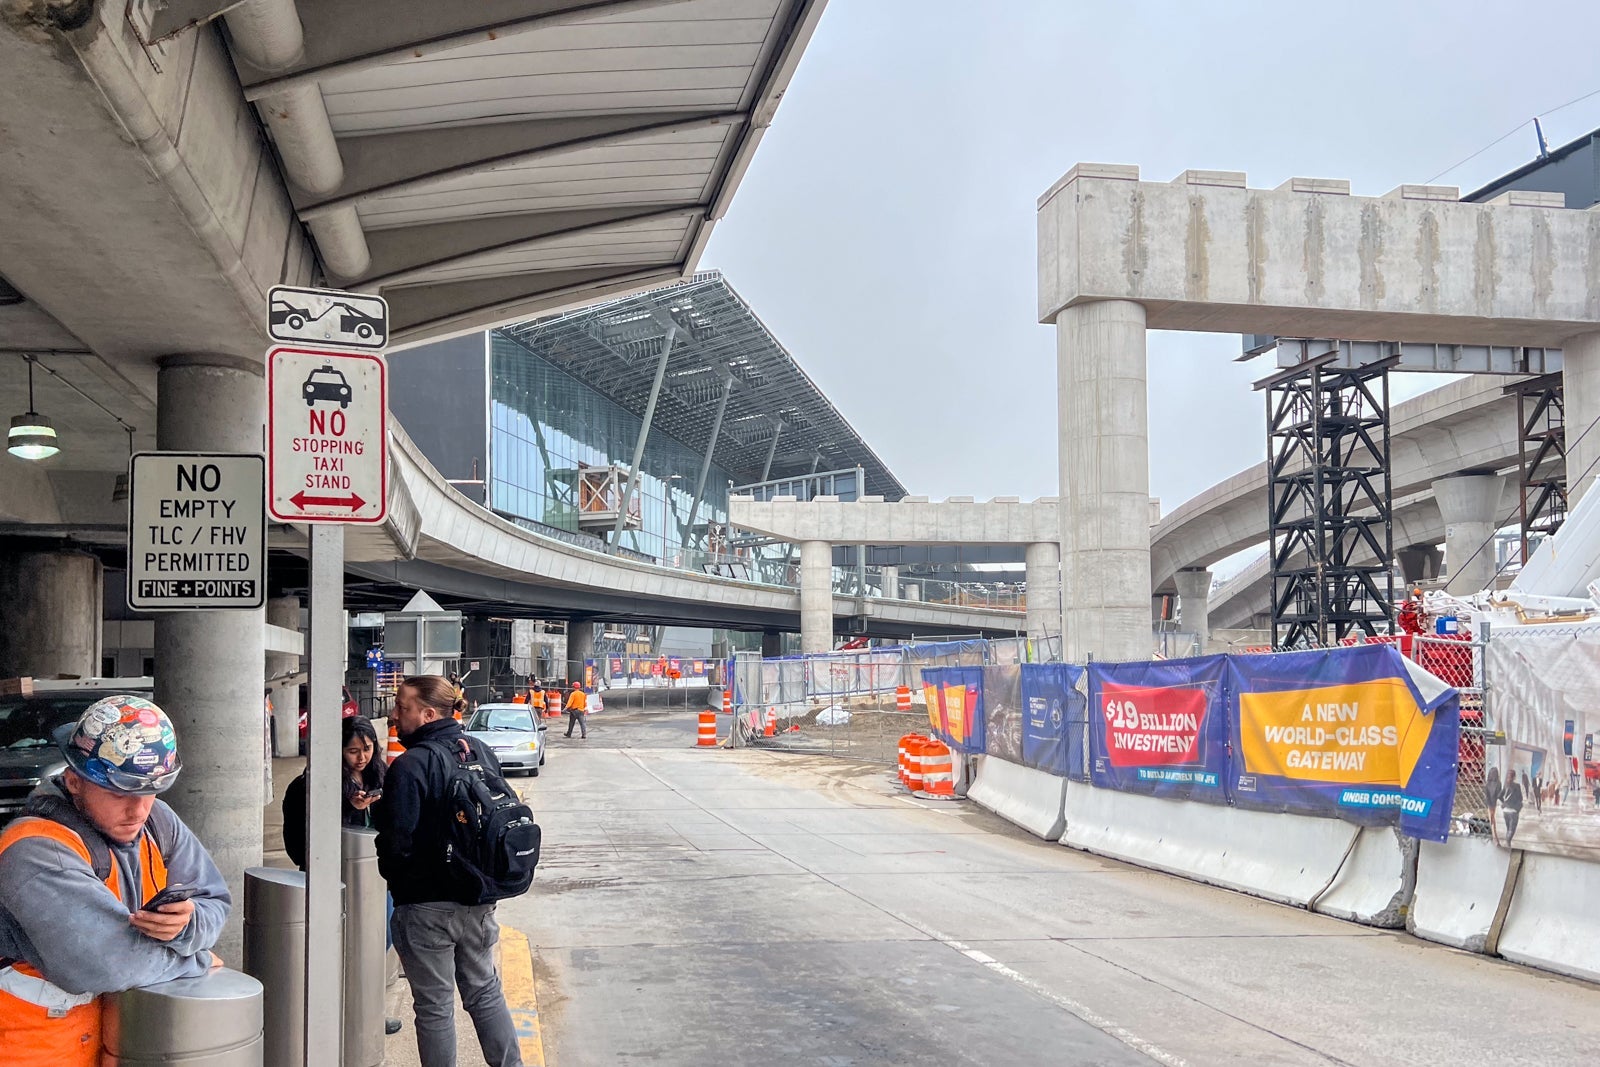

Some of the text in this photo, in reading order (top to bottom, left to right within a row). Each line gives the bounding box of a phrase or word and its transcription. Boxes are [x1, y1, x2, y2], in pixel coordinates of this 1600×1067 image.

[309, 409, 346, 437] NO
[292, 438, 364, 455] STOPPING
[313, 457, 344, 472] TAXI
[176, 464, 221, 492] NO
[305, 474, 351, 490] STAND
[159, 500, 237, 518] EMPTY
[148, 526, 183, 545] TLC
[210, 526, 247, 545] FHV
[144, 553, 250, 572] PERMITTED
[141, 582, 177, 597] FINE
[195, 580, 253, 597] POINTS
[1106, 699, 1198, 732] $19 BILLION
[1301, 702, 1359, 721] A NEW
[1264, 725, 1398, 746] WORLD-CLASS
[1286, 749, 1366, 771] GATEWAY
[1342, 791, 1370, 804] UNDER
